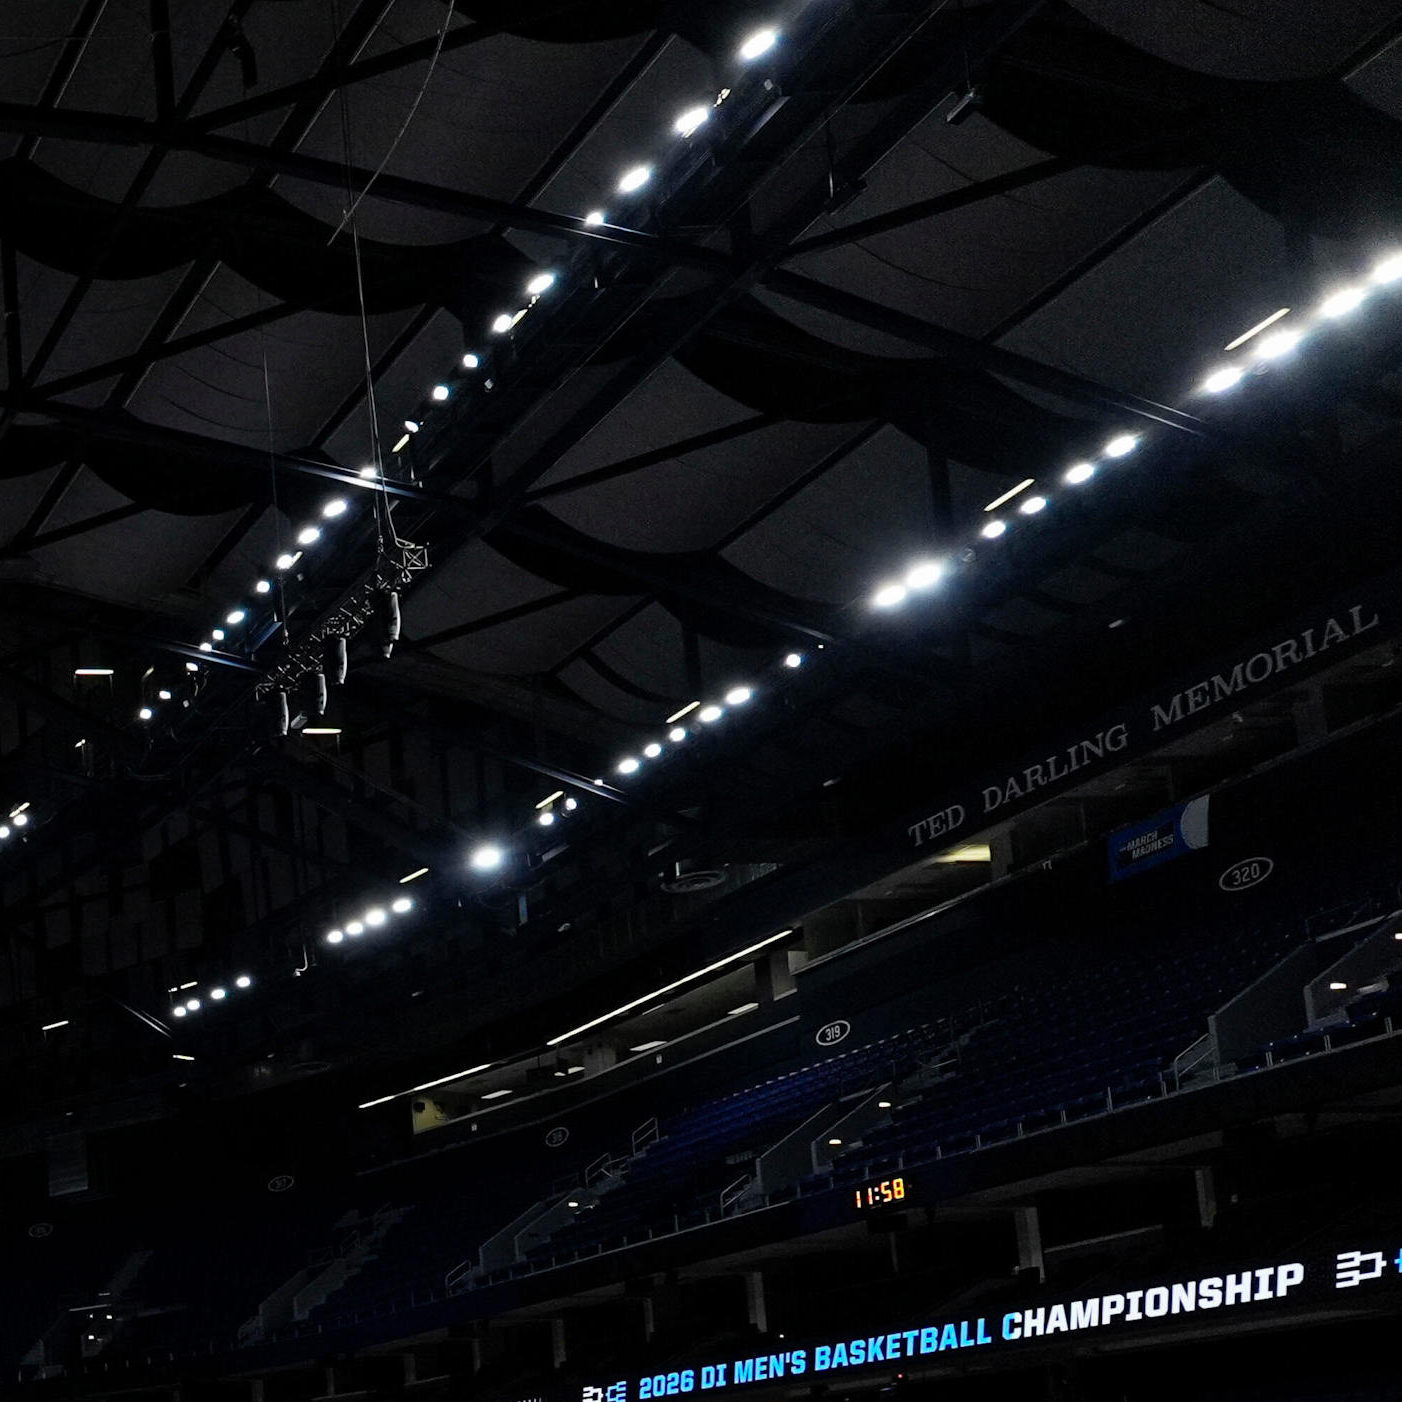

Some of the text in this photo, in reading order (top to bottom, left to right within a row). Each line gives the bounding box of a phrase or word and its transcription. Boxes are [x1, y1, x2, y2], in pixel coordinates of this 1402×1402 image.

[907, 604, 1380, 847] TED DARLING MEMORIAL
[1127, 831, 1158, 851] MARCH
[1132, 834, 1174, 860] MADNESS
[1231, 862, 1260, 885] 320
[855, 1178, 905, 1209] 11:58
[639, 1263, 1305, 1400] 2026 DI MEN'S BASKETBALL CHAMPIONSHIP
